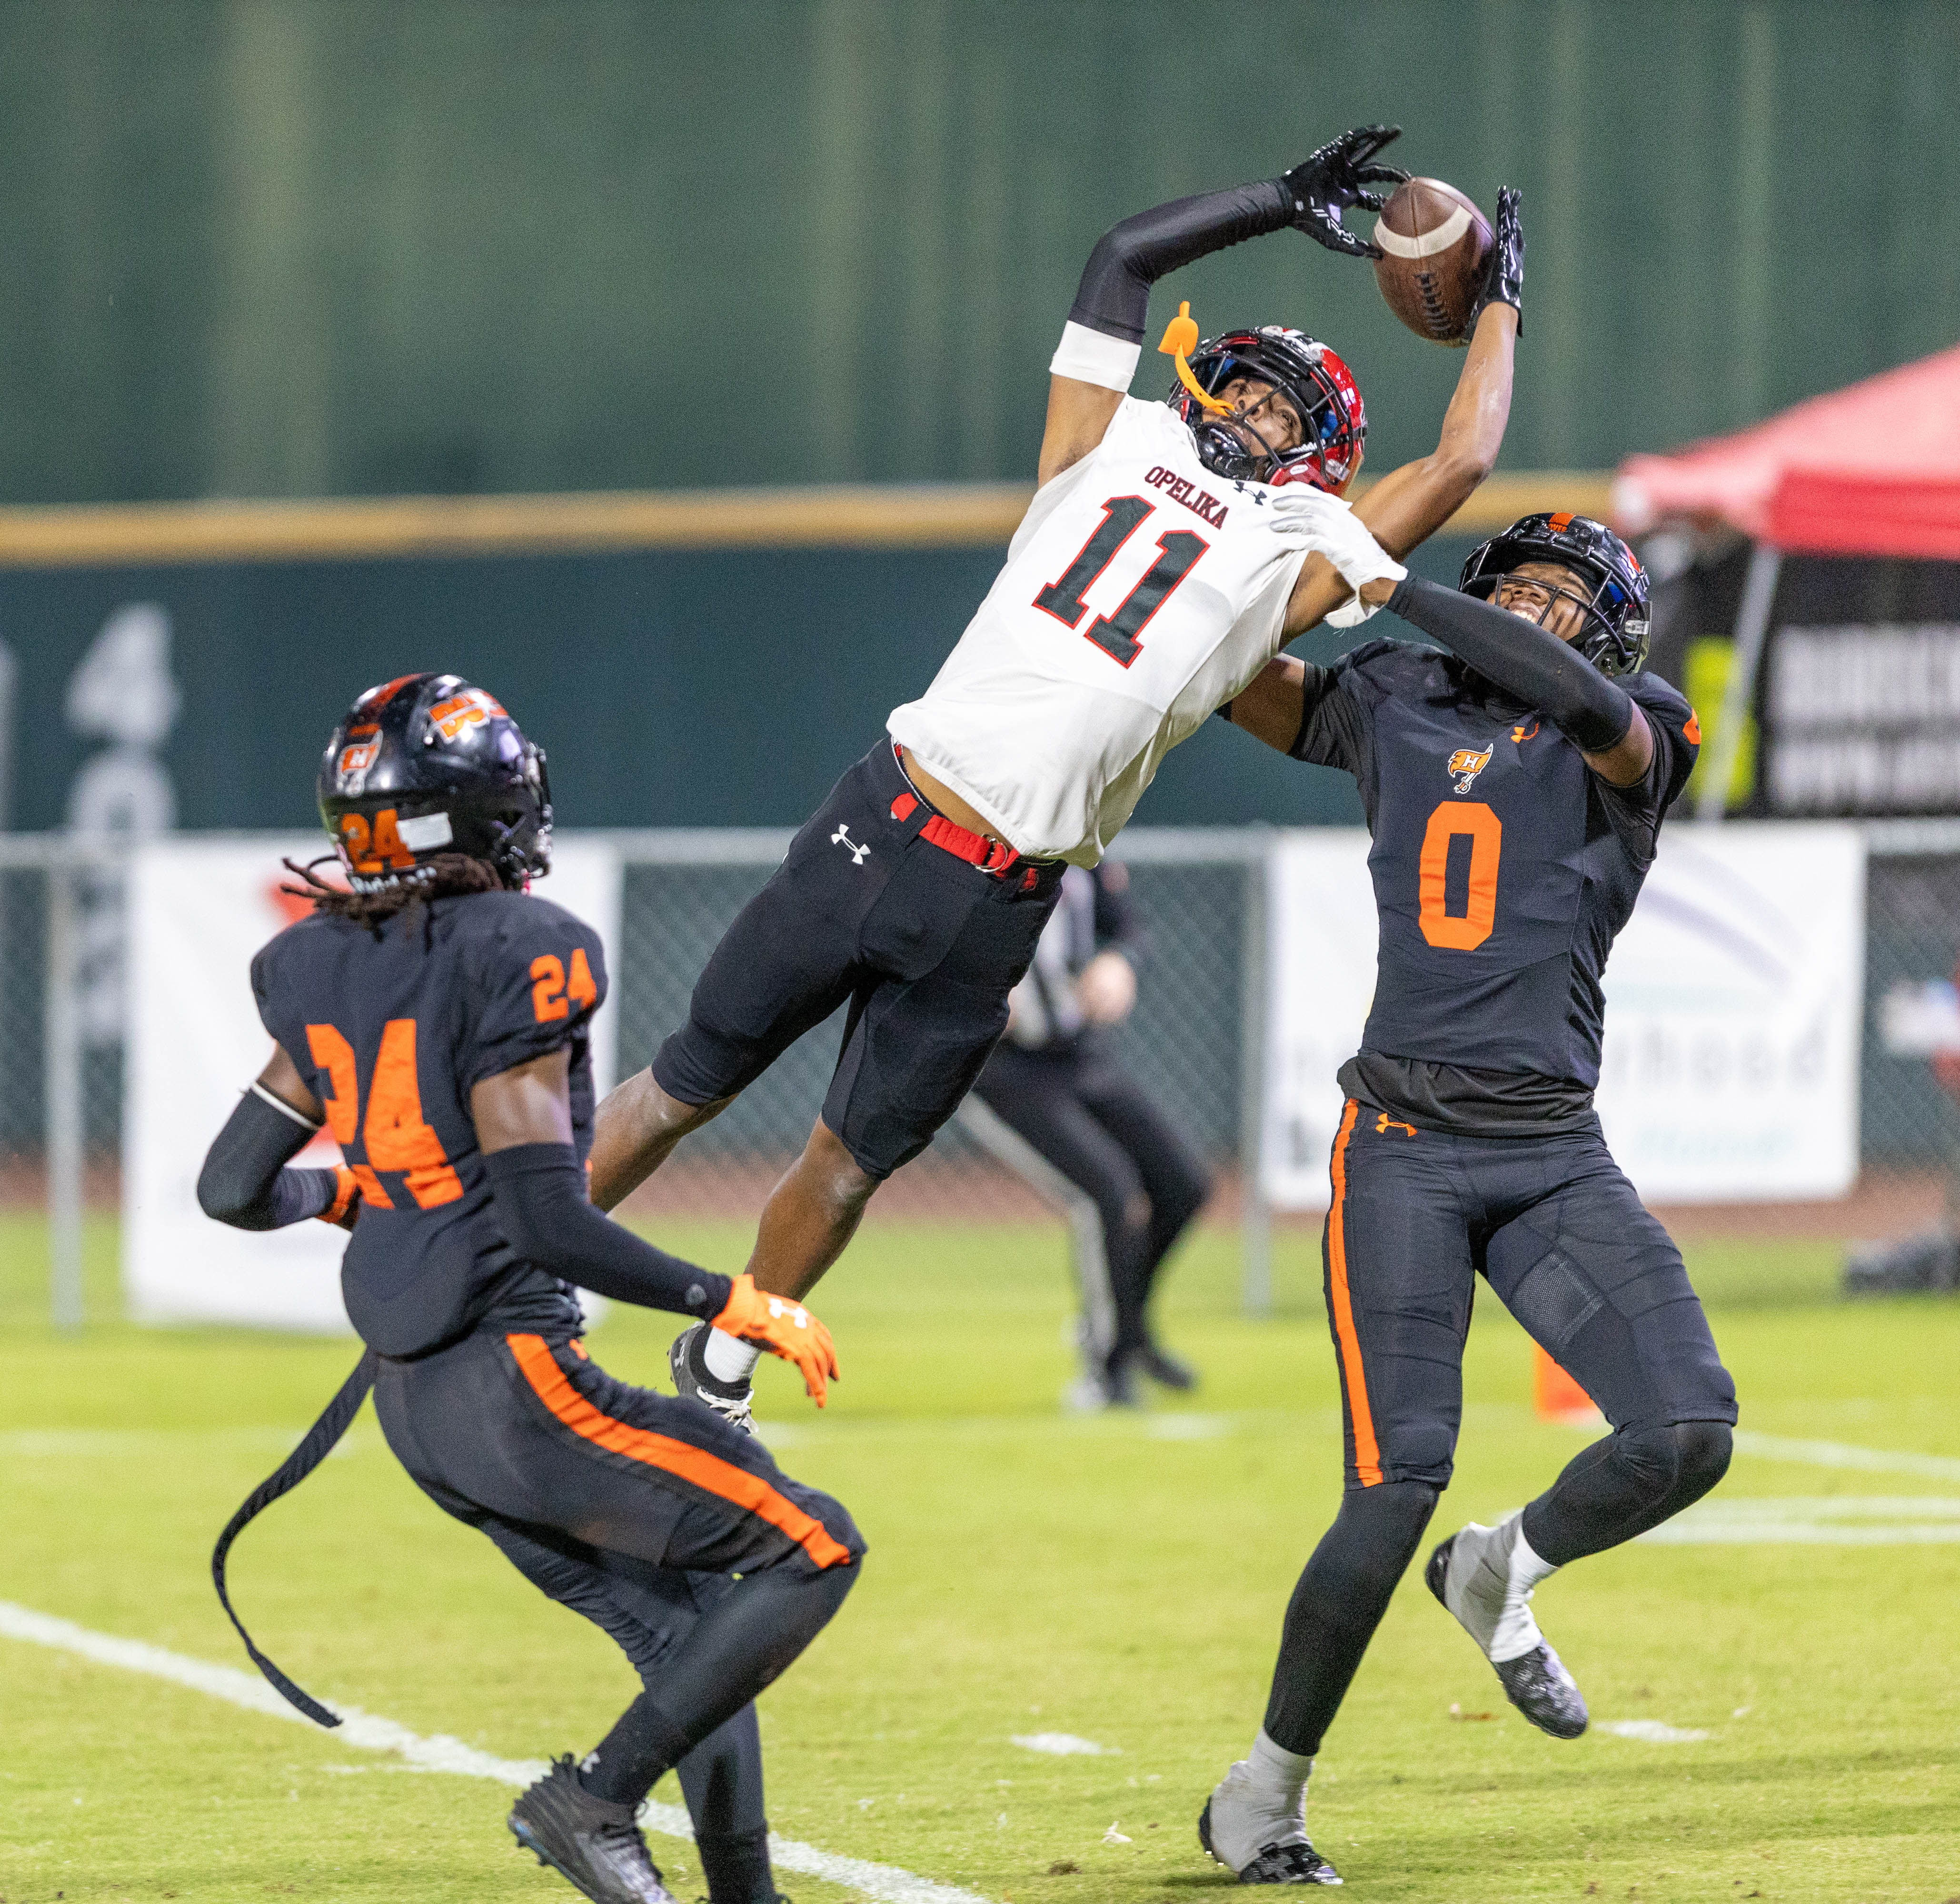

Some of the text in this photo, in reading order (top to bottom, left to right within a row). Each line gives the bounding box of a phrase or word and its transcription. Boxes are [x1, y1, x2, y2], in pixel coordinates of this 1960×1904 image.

[1144, 466, 1229, 530] OPELIKA
[1031, 495, 1210, 669] 11
[342, 809, 415, 873] 24
[1419, 801, 1502, 951] 0
[529, 948, 597, 1023] 24
[306, 1018, 464, 1210] 24
